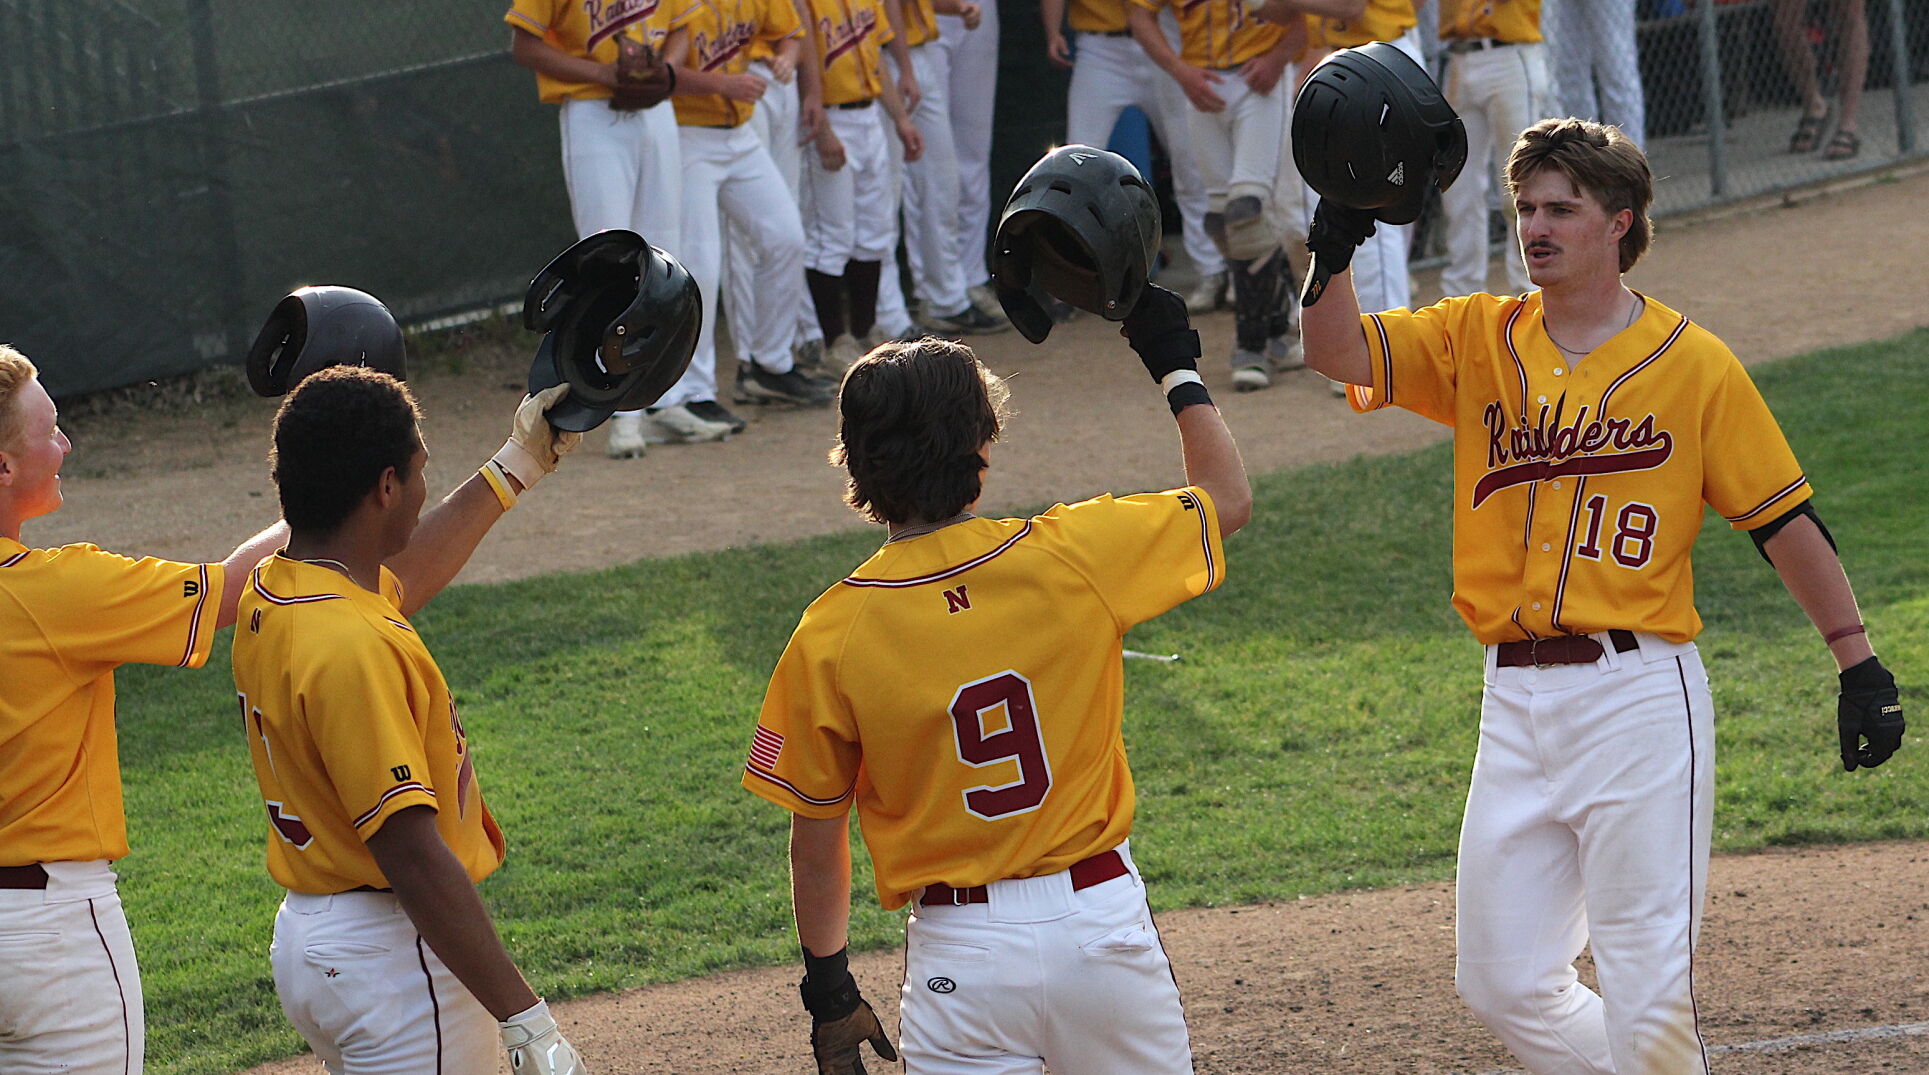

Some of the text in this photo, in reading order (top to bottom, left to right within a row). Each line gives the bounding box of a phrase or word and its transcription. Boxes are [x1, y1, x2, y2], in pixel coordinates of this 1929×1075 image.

[1177, 495, 1195, 511] W
[1575, 493, 1660, 570] 18
[183, 580, 199, 598] W
[942, 584, 973, 614] N
[947, 669, 1053, 822] 9
[390, 764, 411, 782] W
[928, 977, 955, 993] R
